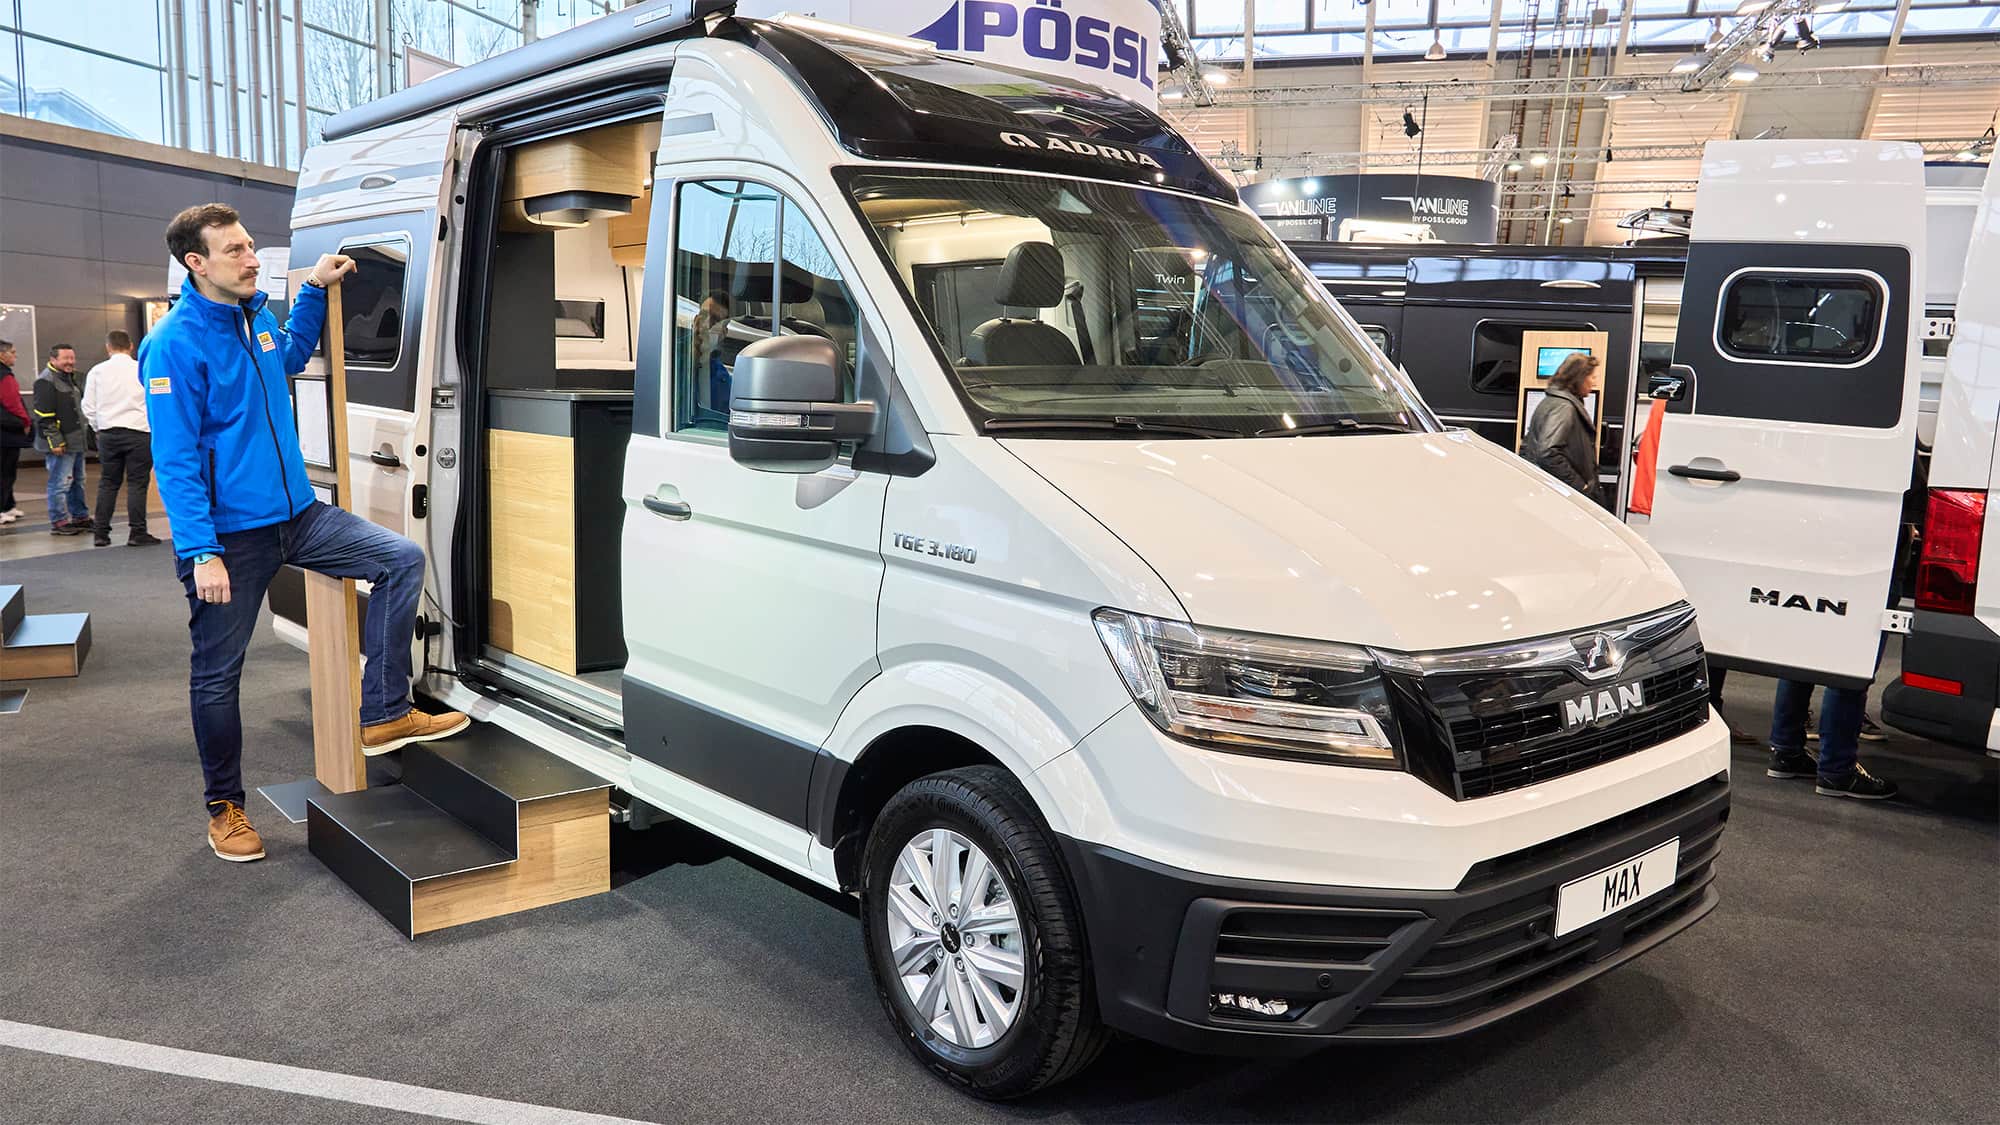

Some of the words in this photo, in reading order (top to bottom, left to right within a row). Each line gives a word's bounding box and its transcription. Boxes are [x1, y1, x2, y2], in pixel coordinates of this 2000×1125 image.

[964, 0, 1154, 90] PÖSSL
[1046, 137, 1163, 169] ADRIA
[1258, 198, 1337, 216] VANLINE
[1381, 196, 1470, 216] VANLINE
[1155, 273, 1185, 285] Twin
[893, 531, 925, 553] TGE
[927, 540, 978, 564] 3.180
[1749, 586, 1848, 617] MAN
[1564, 682, 1644, 729] MAN
[1603, 860, 1644, 912] MAX
